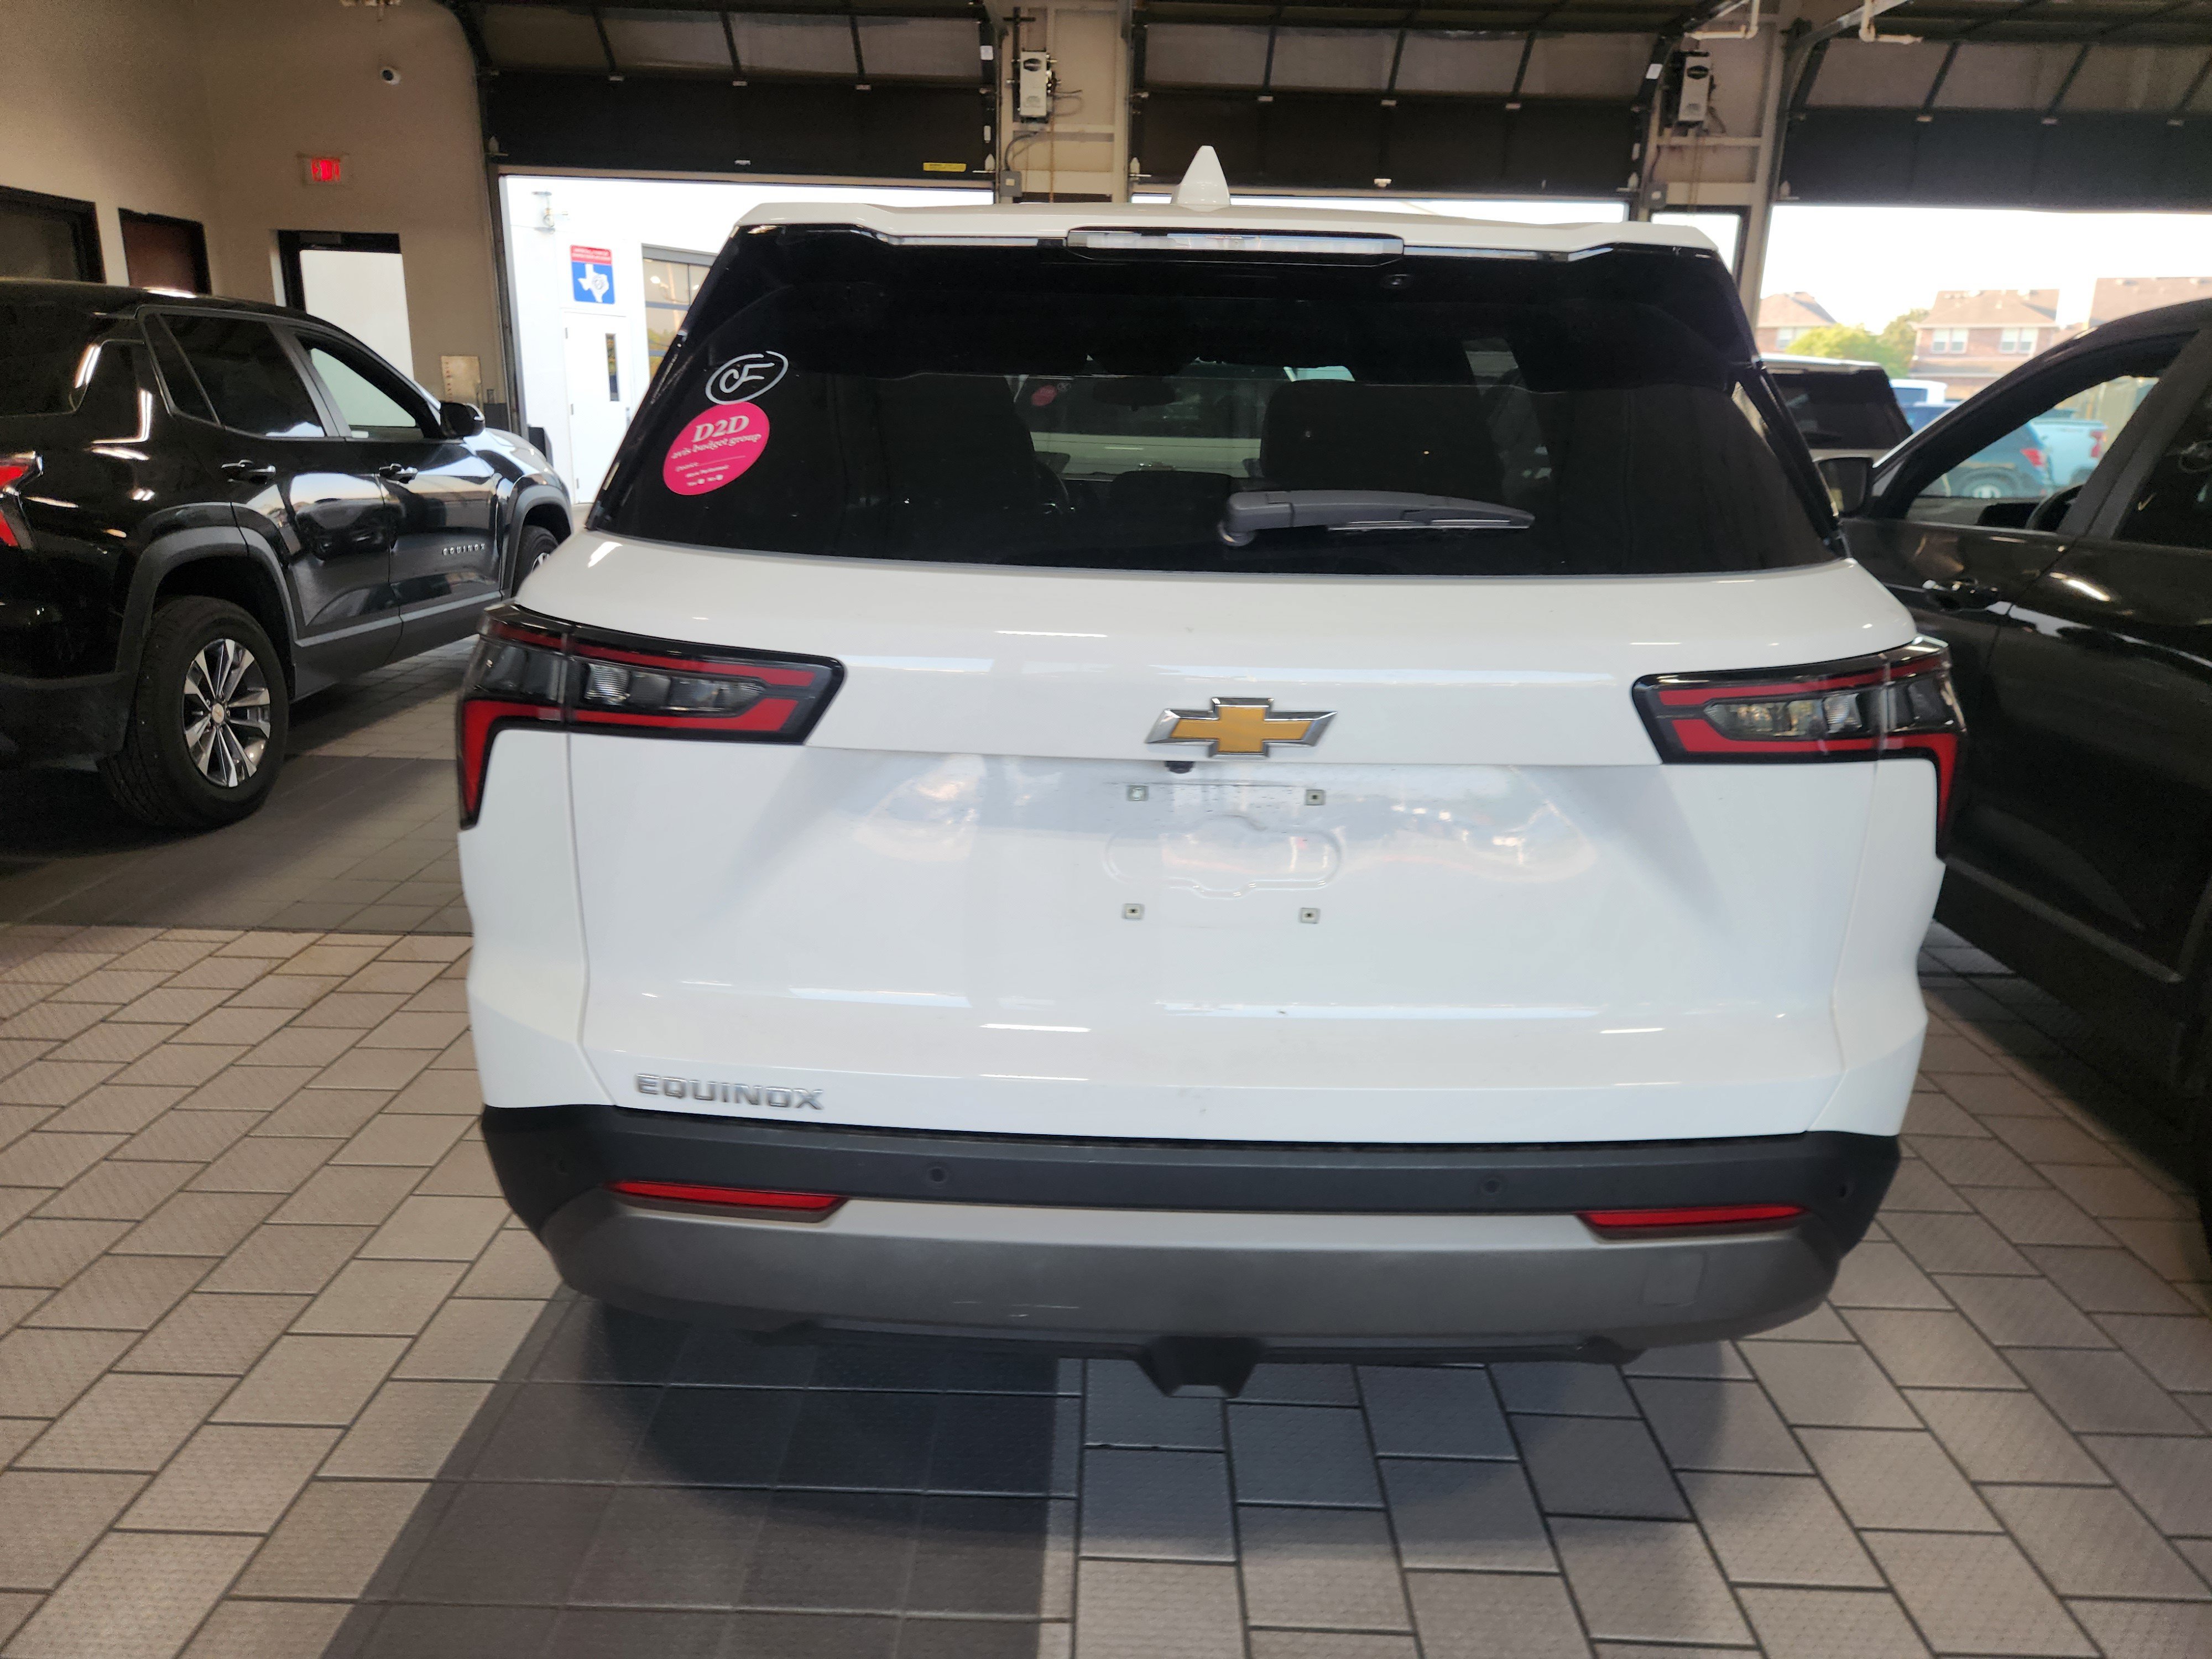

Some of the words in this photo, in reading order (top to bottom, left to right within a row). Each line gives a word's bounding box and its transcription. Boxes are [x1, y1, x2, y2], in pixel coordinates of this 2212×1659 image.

[692, 415, 750, 443] D2D
[692, 438, 728, 453] budget
[728, 434, 762, 446] group
[442, 543, 485, 556] EQUINOX
[635, 1073, 825, 1110] EQUINOX
